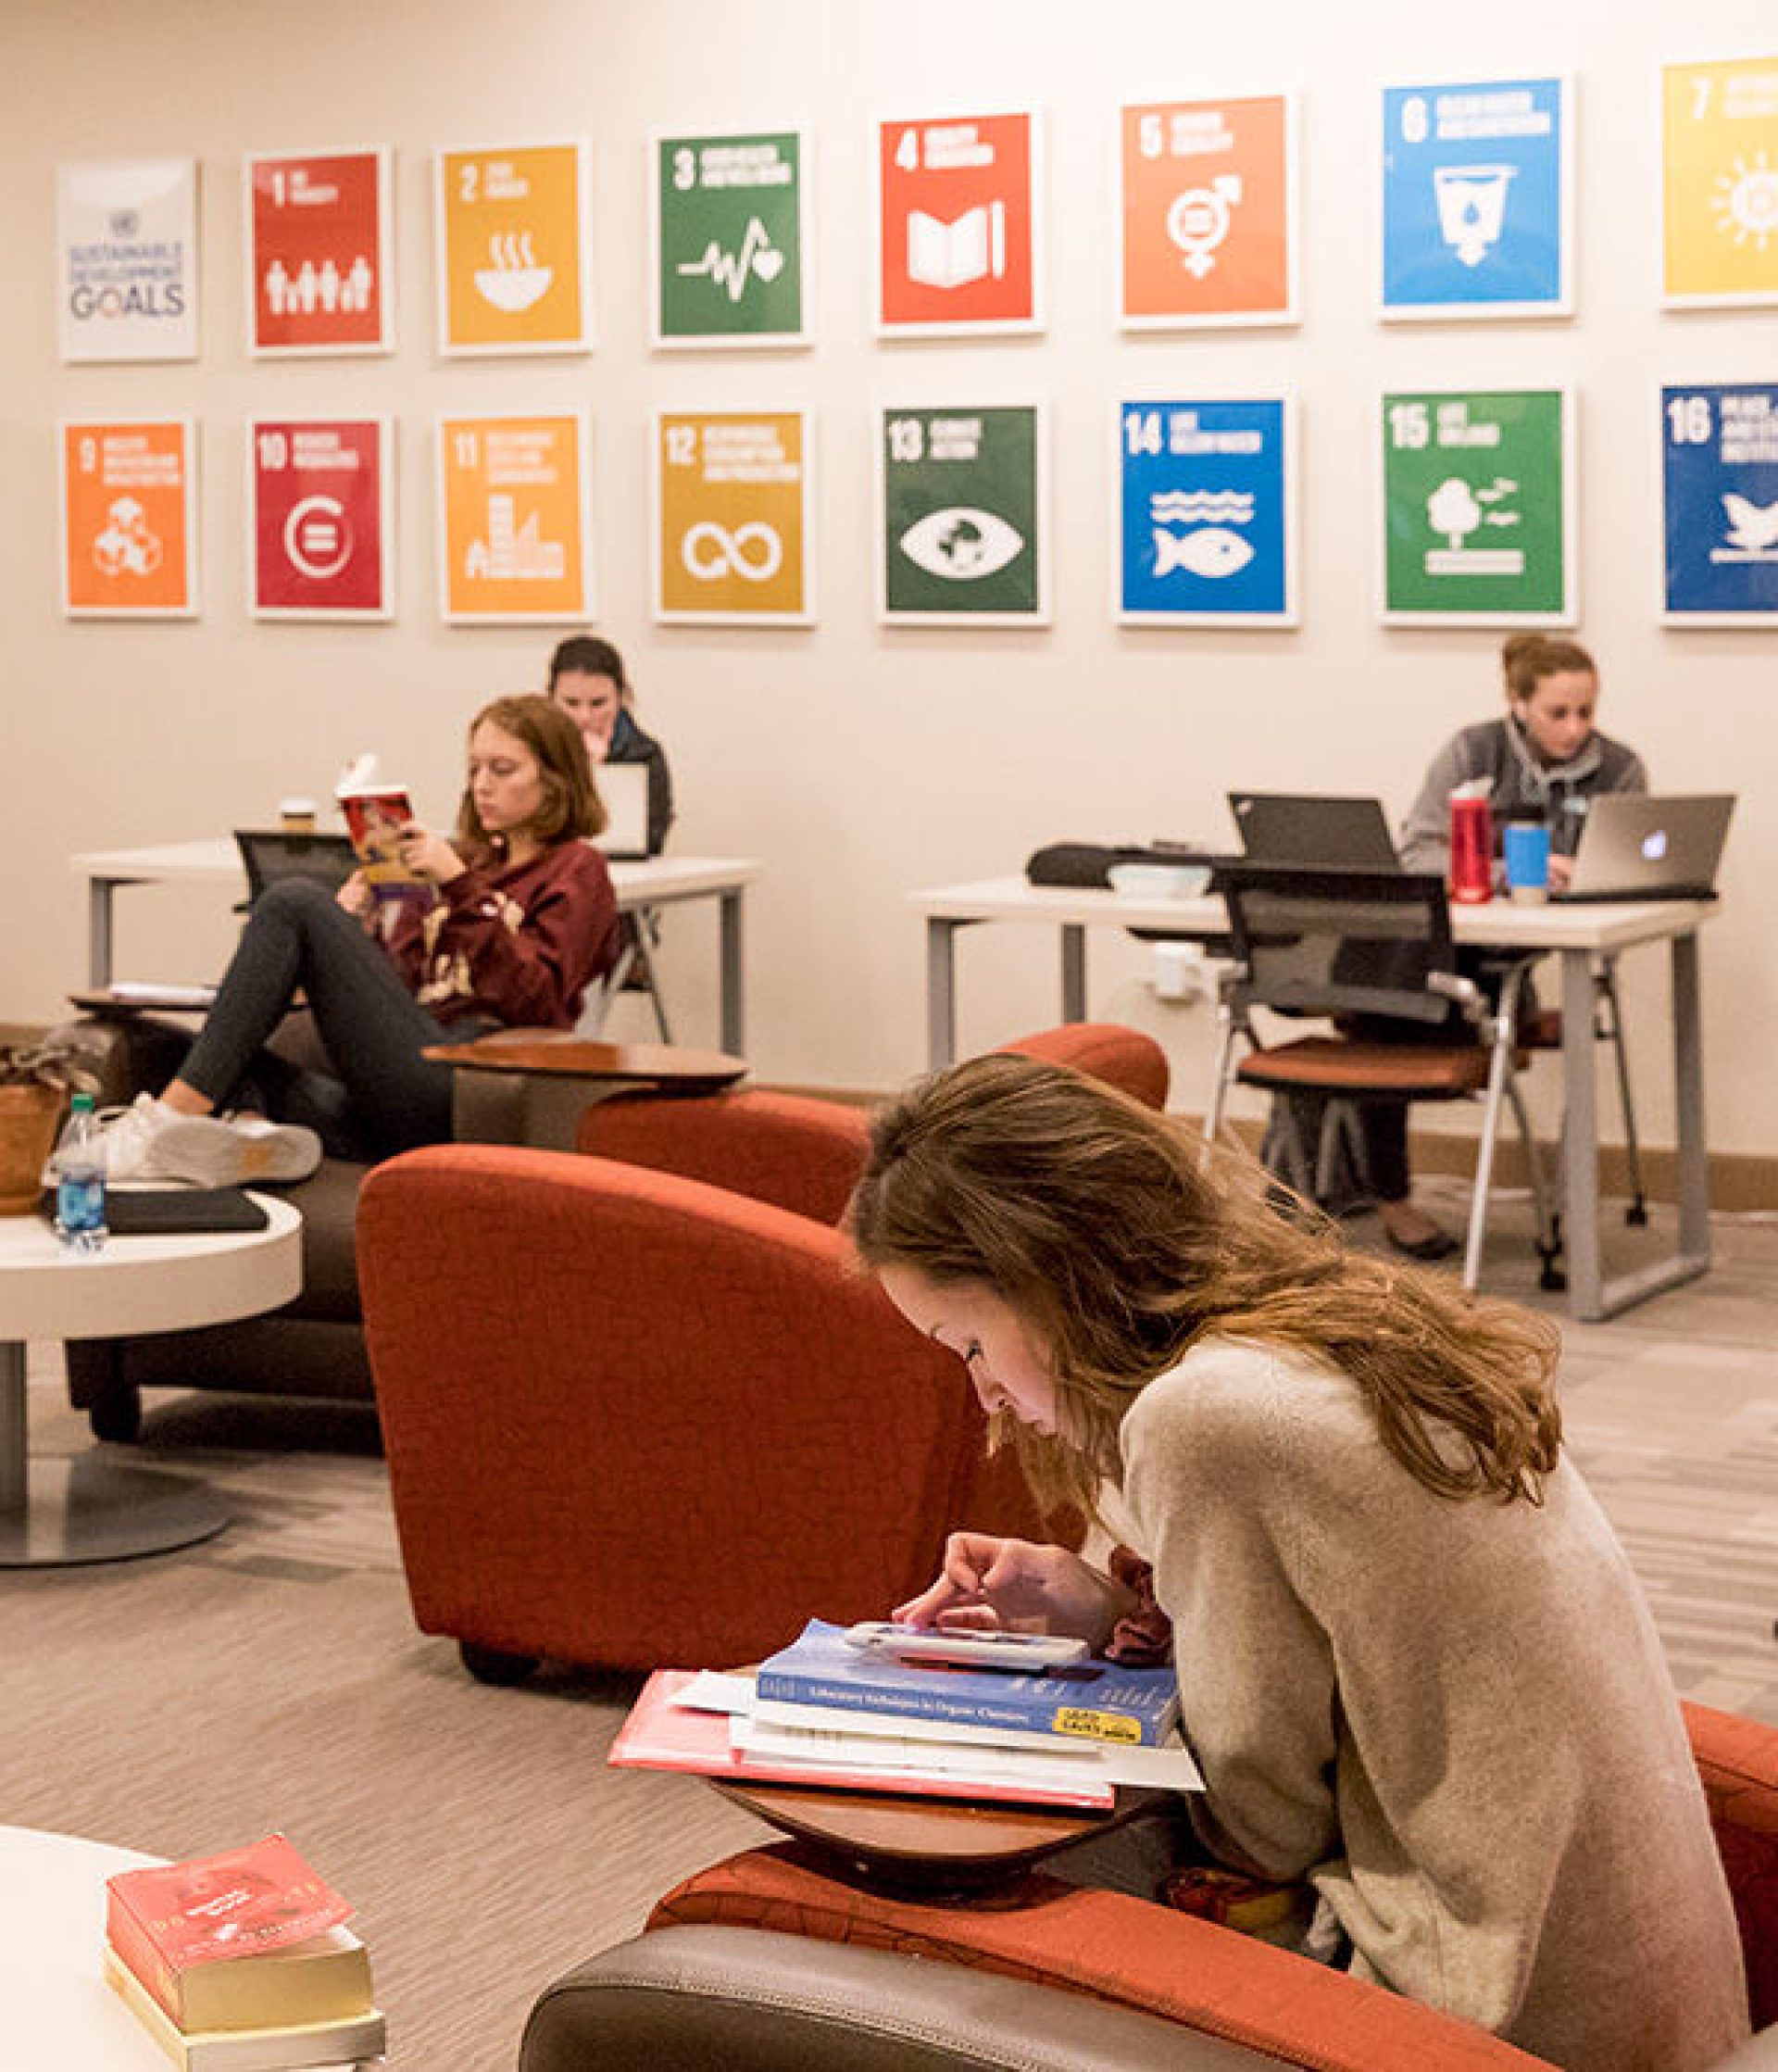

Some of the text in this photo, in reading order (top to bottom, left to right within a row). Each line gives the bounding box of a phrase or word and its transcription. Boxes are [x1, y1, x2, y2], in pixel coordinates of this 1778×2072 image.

[1690, 76, 1712, 120] 7
[895, 128, 919, 171] 4
[1140, 114, 1163, 158] 5
[271, 169, 286, 206] 1
[460, 164, 478, 203] 2
[674, 147, 695, 191] 3
[70, 283, 184, 320] GOALS
[889, 418, 923, 461] 13
[1122, 411, 1163, 455] 14
[1390, 402, 1430, 448] 15
[1668, 396, 1712, 444] 16
[258, 432, 288, 470] 10
[454, 432, 479, 469] 11
[666, 425, 696, 466] 12
